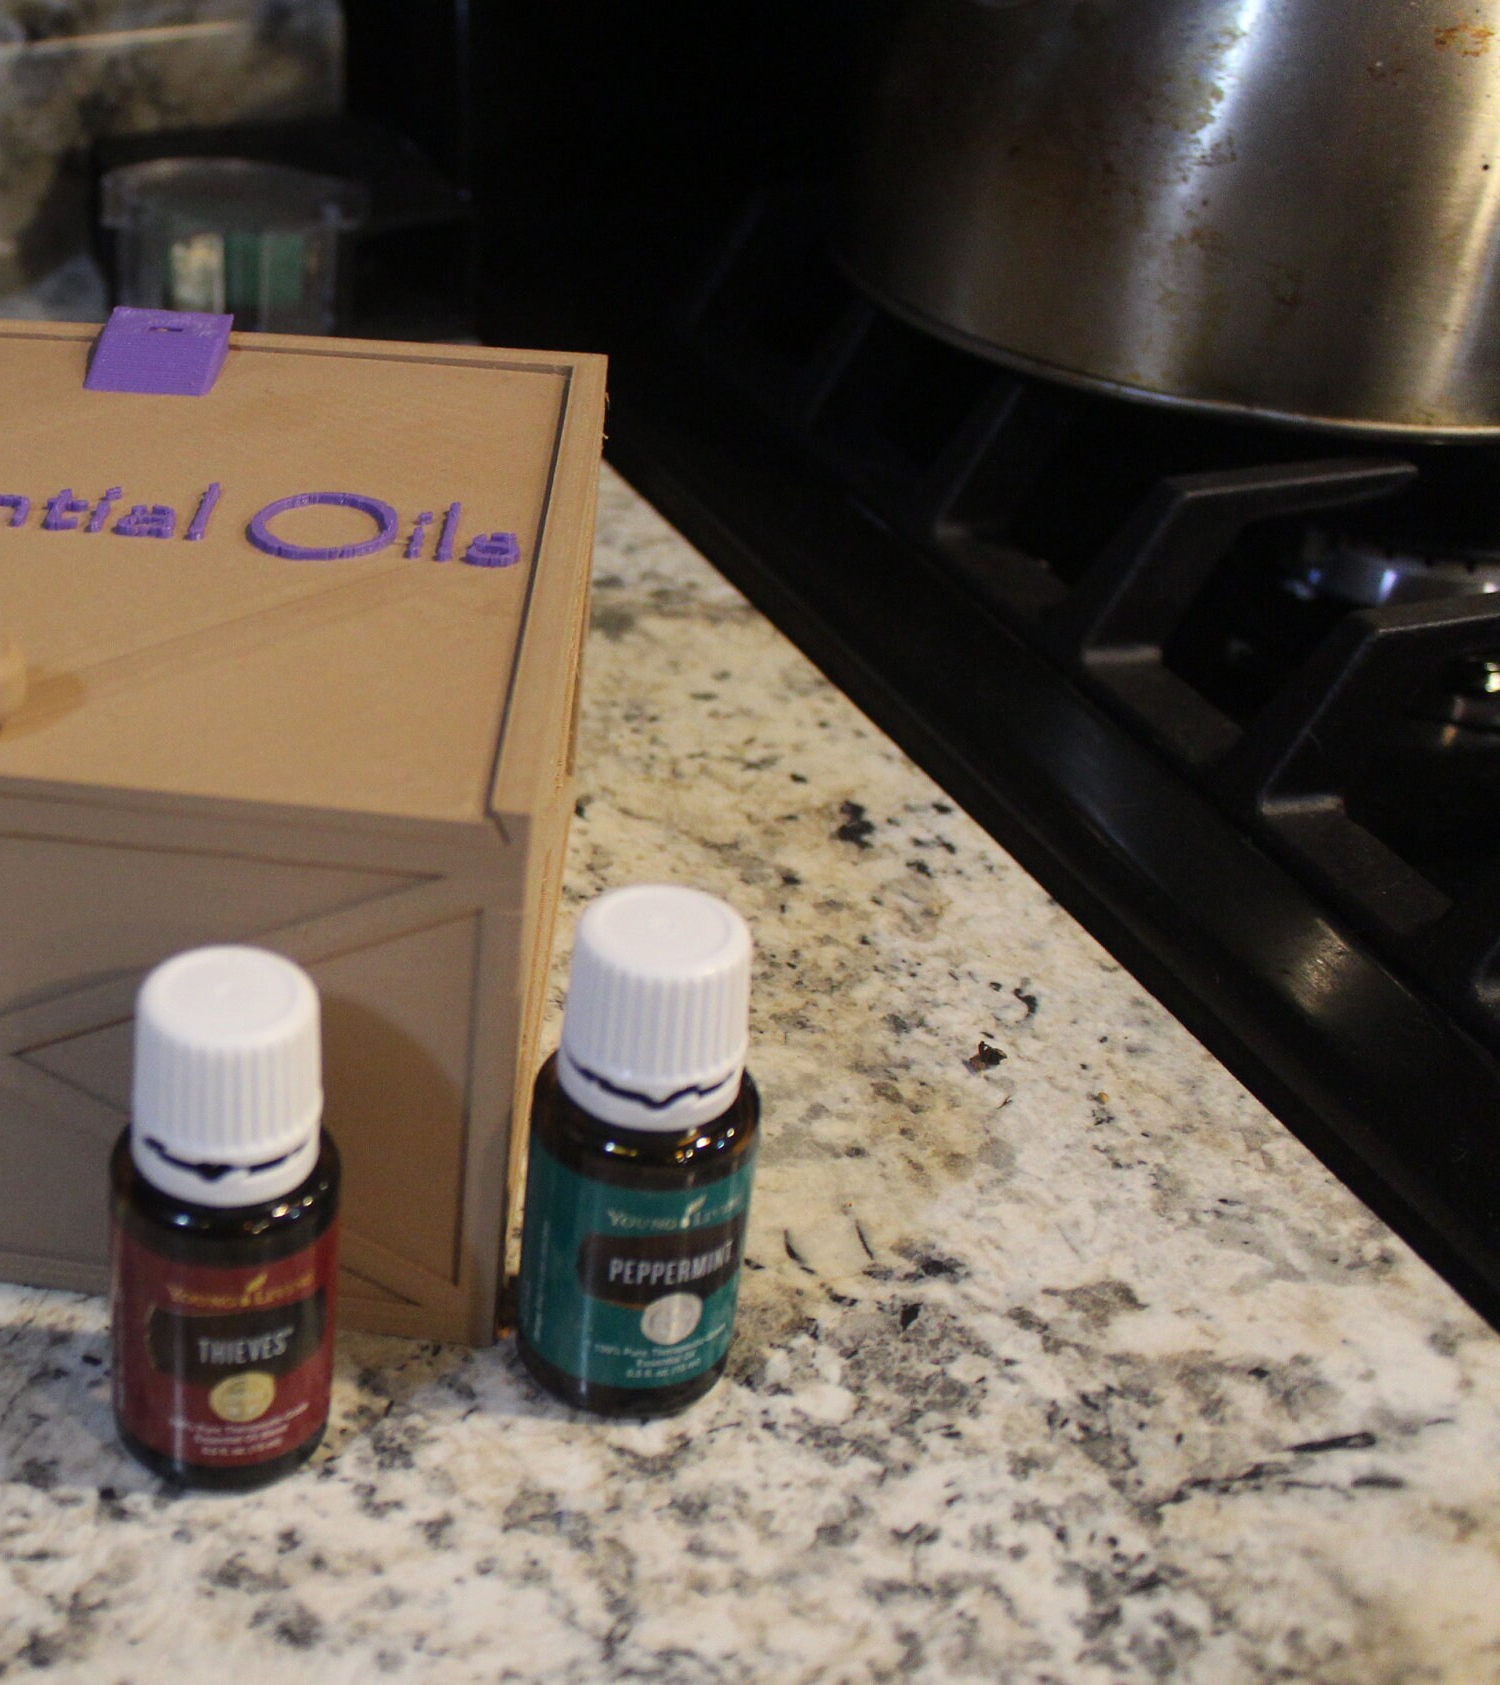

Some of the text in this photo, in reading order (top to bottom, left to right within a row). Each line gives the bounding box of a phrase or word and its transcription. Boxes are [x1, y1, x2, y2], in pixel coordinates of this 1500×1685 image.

[247, 492, 521, 567] Oils
[608, 1238, 734, 1285] PEPPERMINT
[197, 1329, 289, 1365] THIEVES
